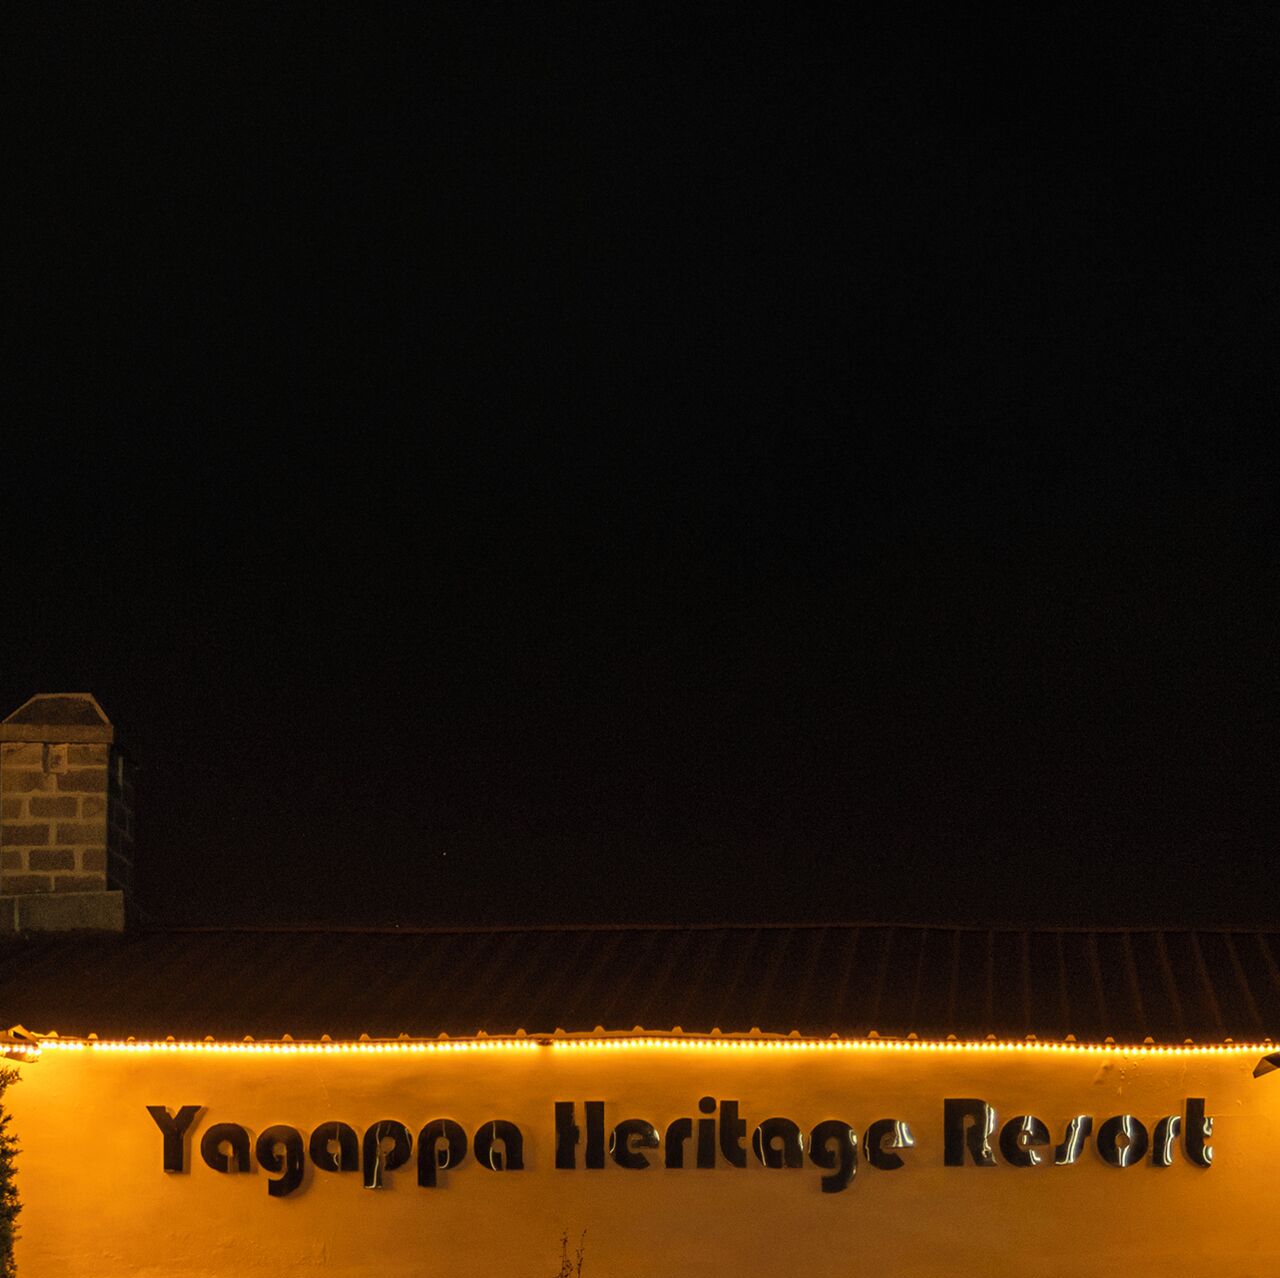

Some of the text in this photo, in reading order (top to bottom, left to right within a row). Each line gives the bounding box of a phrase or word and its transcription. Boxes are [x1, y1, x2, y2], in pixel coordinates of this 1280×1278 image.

[145, 1095, 1214, 1198] Yagappa Heritage Resort
